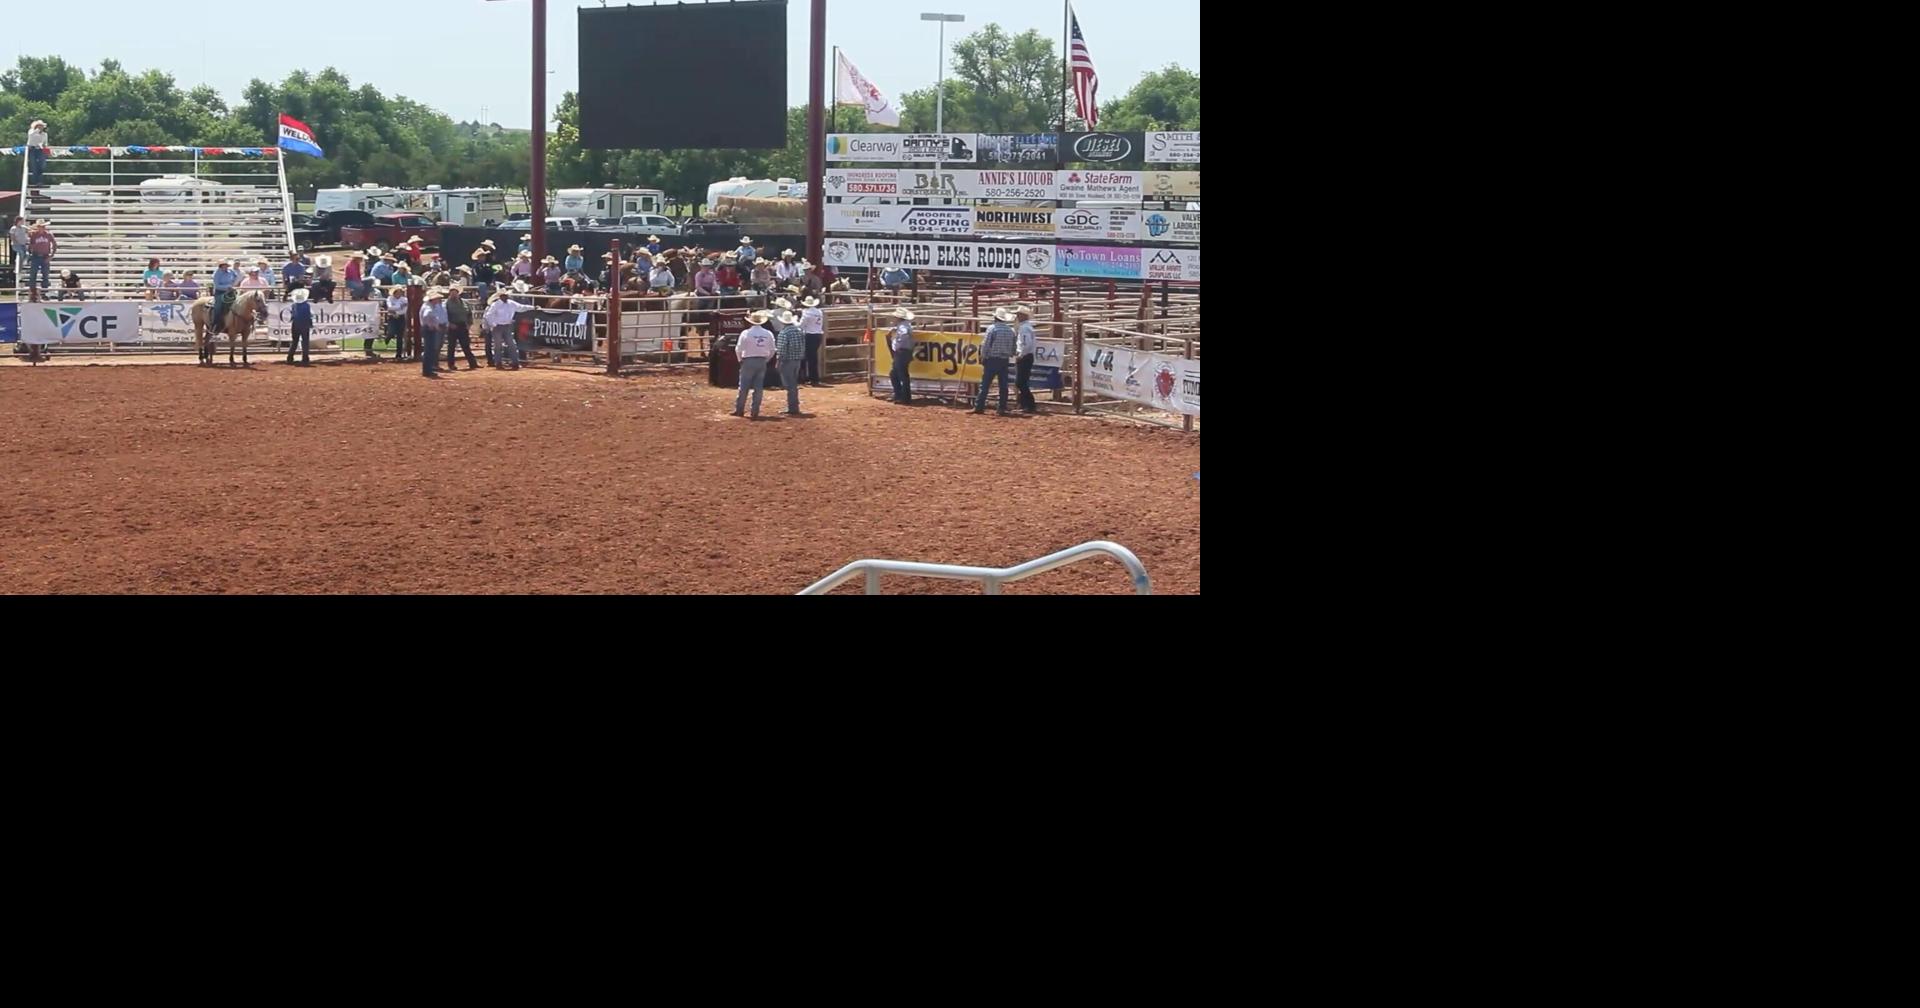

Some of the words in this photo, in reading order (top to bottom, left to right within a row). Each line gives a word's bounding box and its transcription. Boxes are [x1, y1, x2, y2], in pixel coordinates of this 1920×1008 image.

[850, 139, 898, 155] Clearway
[1152, 133, 1193, 151] SMITH
[978, 171, 1015, 185] ANNIE'S
[1018, 171, 1053, 186] LIQUOR
[848, 184, 896, 193] 580.571.1736
[985, 188, 1046, 197] 580-256-2520
[1119, 185, 1140, 193] Agent
[908, 219, 970, 227] ROOFING
[976, 211, 1053, 224] NORTHWEST
[1064, 215, 1100, 225] GDC
[855, 243, 931, 265] WOODWARD
[937, 245, 970, 267] ELKS
[977, 246, 1021, 269] RODEO
[1110, 250, 1142, 263] Loans
[280, 308, 367, 324] Oahoma
[79, 316, 117, 338] CF
[534, 318, 587, 340] PENDLETON
